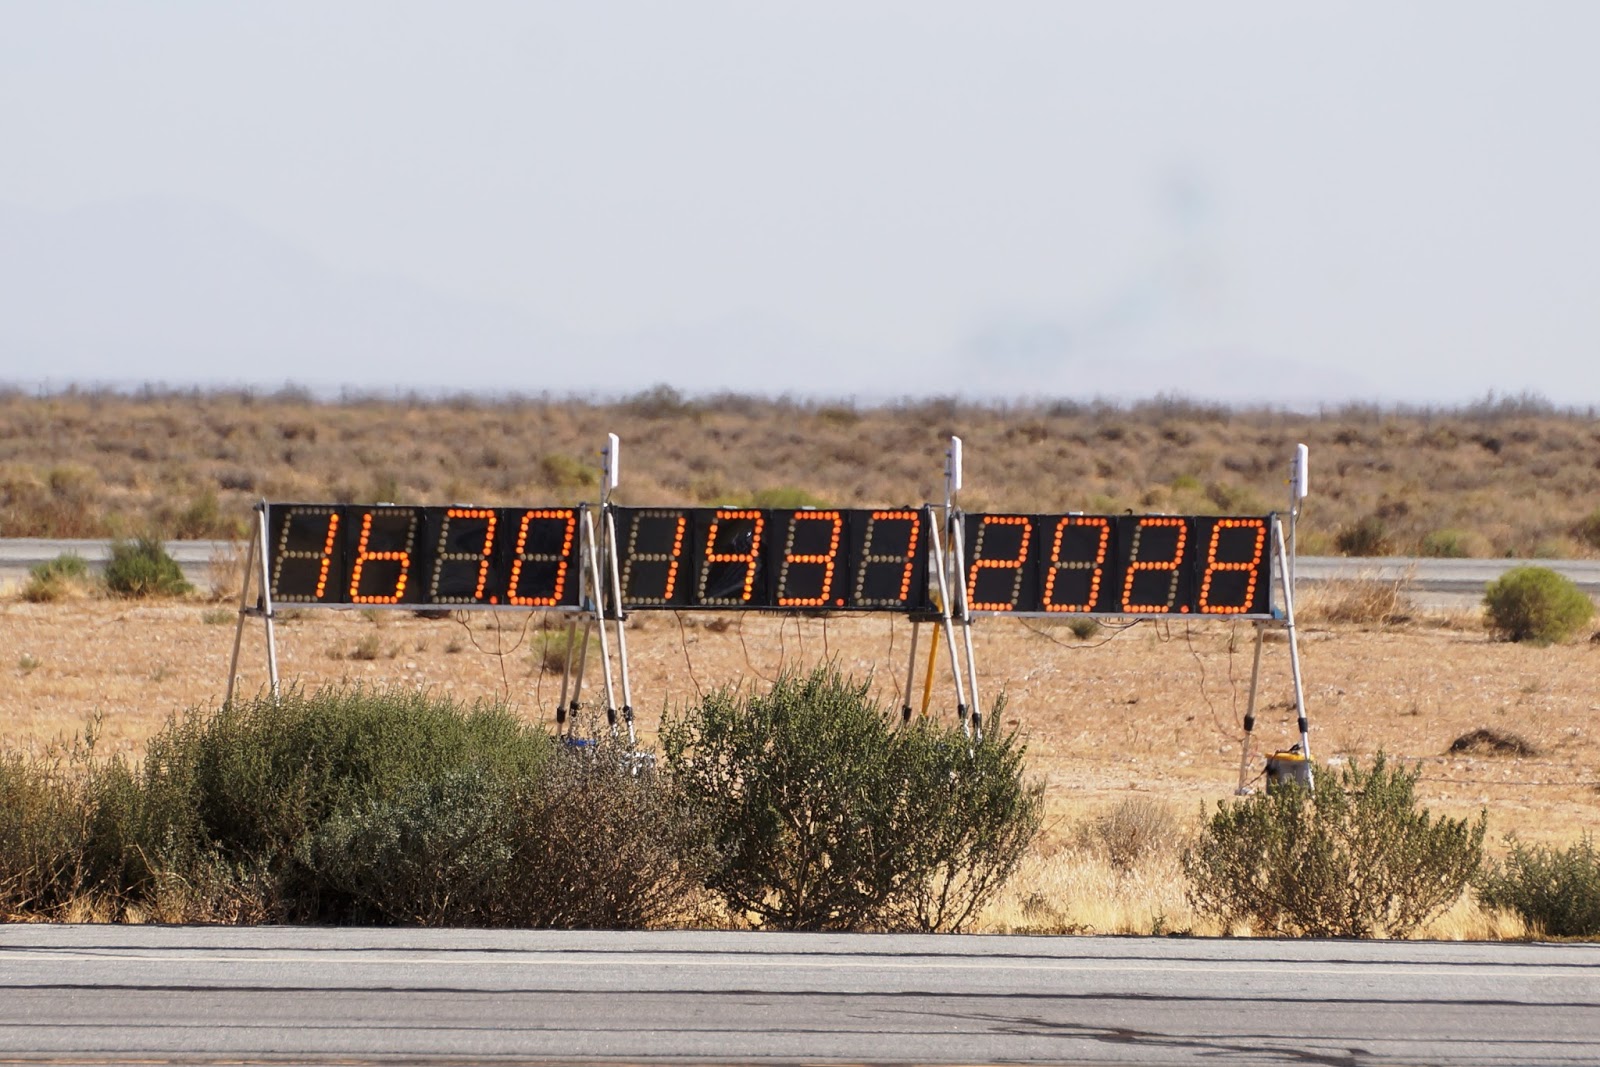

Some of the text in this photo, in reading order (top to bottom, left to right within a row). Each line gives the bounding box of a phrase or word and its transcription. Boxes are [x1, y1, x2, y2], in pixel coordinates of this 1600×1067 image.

[316, 509, 576, 607] 167.0
[665, 510, 920, 606] 193.7
[967, 516, 1267, 614] 202.8
